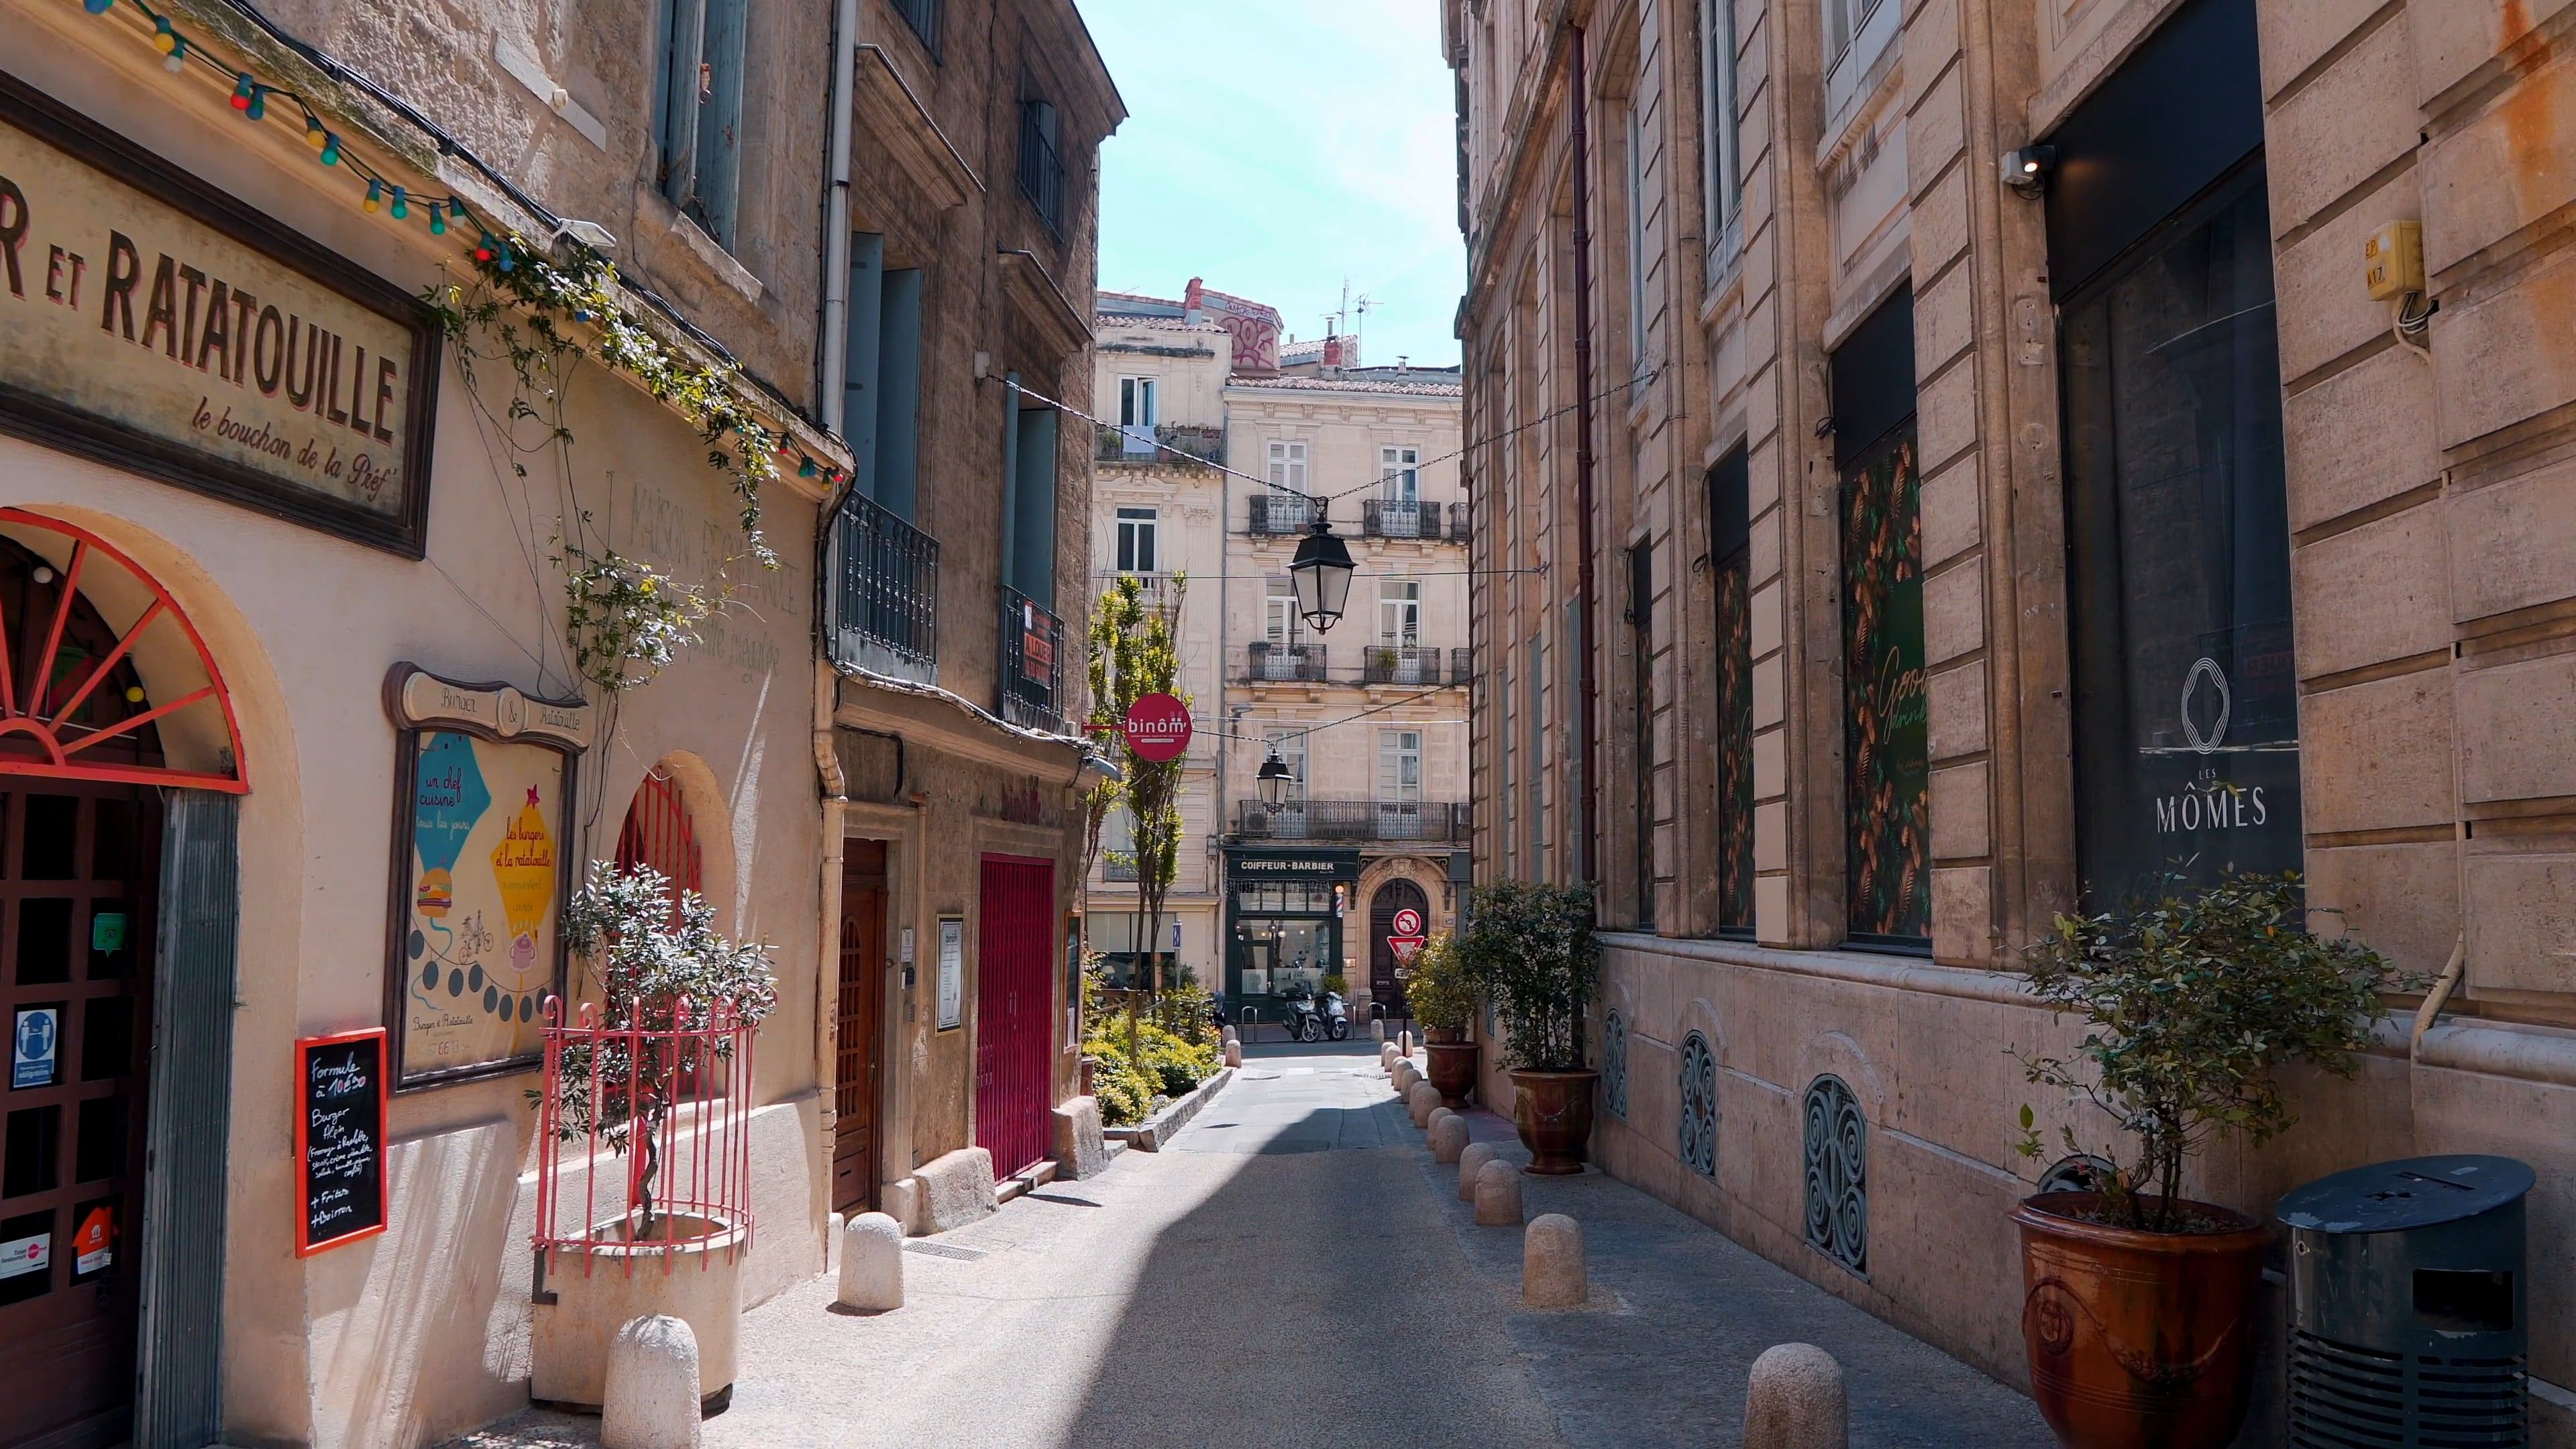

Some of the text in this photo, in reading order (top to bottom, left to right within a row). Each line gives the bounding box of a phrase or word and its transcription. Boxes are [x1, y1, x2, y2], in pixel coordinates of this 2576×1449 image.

[2365, 240, 2375, 257] EP
[46, 243, 87, 311] ET
[101, 229, 398, 446] RATATOUILLE
[193, 396, 211, 429] le
[217, 406, 291, 460] bouchon
[297, 439, 318, 470] de
[325, 446, 341, 478] la
[1031, 638, 1051, 665] LOUER
[441, 688, 580, 731] Burger & Ratatouille
[425, 766, 462, 803] un chef
[2199, 769, 2216, 780] LES
[420, 794, 455, 807] cuisine
[2157, 781, 2266, 833] MÔMES
[416, 809, 470, 841] tous les jours
[506, 816, 544, 854] les burgers
[496, 843, 551, 867] et la ratatouille
[1241, 861, 1334, 870] COIFFEUR-BARBIER
[311, 1051, 361, 1083] Formule
[312, 1108, 350, 1128] Burger
[323, 1124, 344, 1140] Alpin
[321, 1188, 350, 1204] Frites
